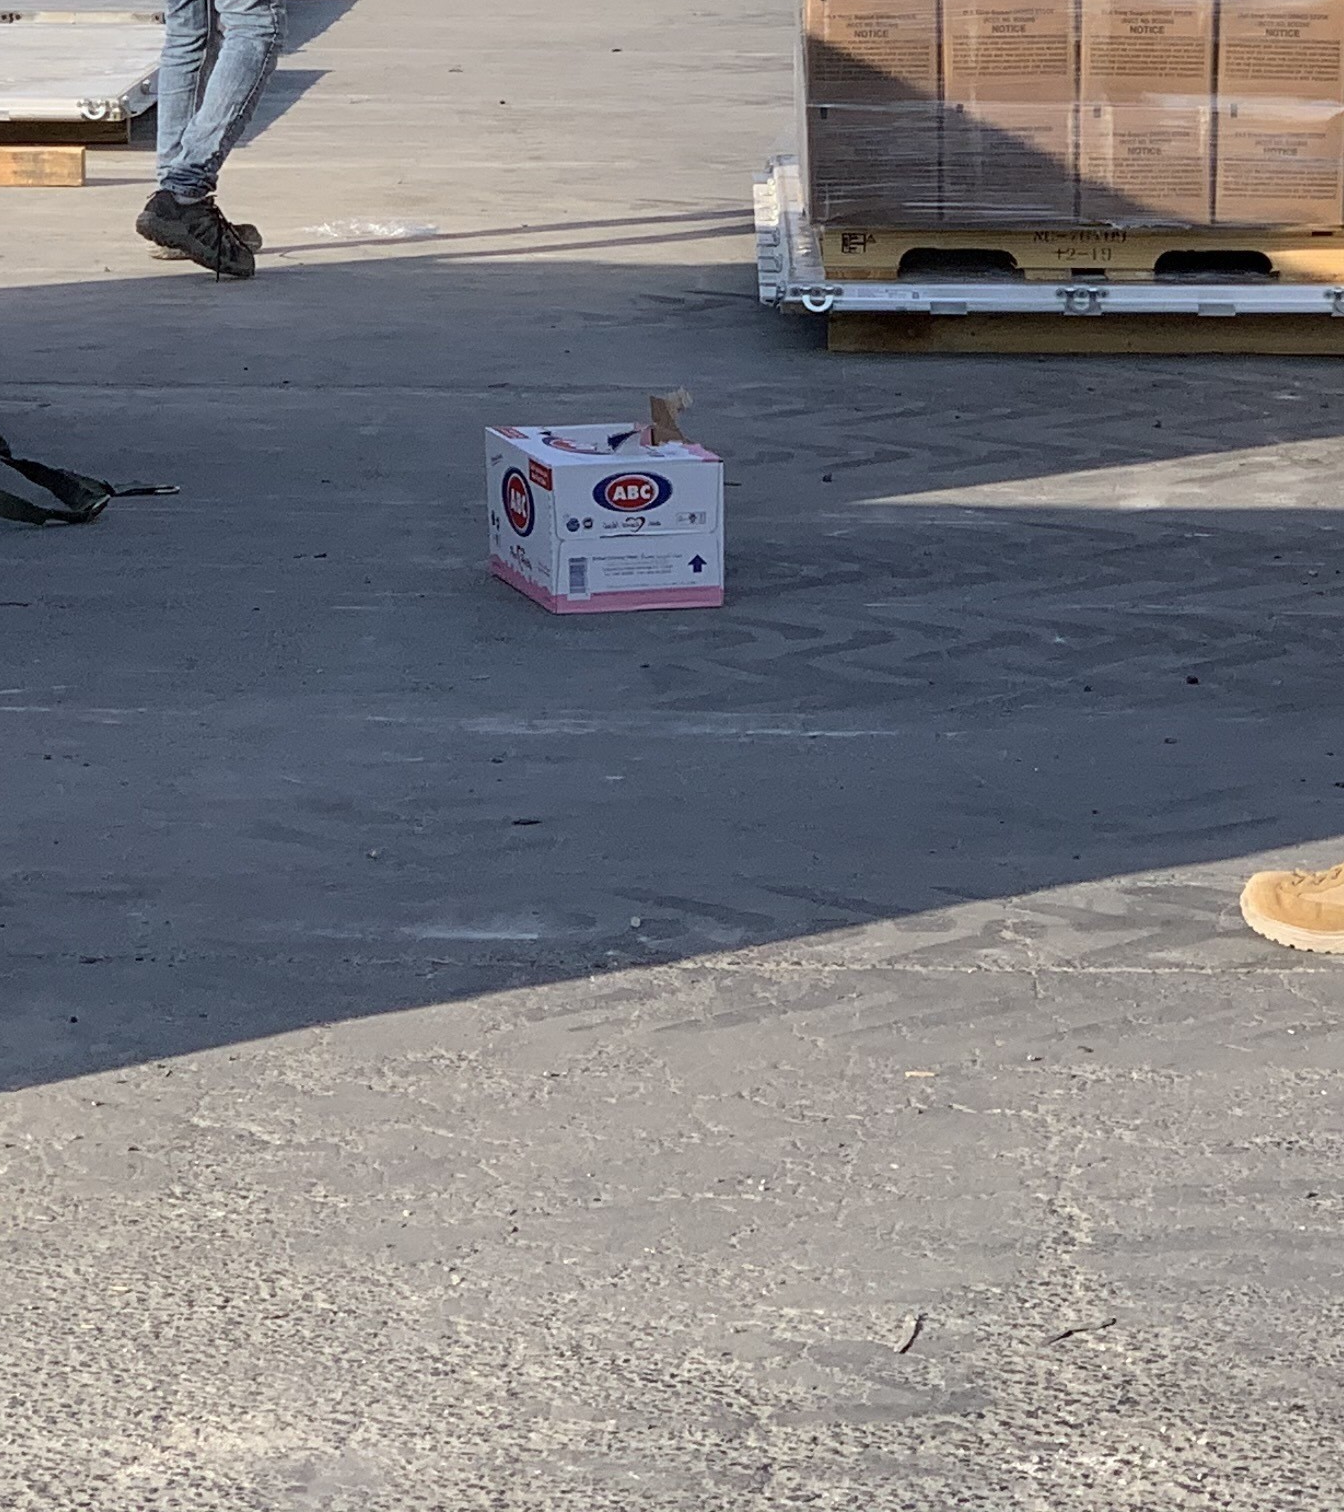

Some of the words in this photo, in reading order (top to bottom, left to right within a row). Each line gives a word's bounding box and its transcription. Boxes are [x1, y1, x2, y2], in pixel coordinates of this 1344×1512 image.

[991, 24, 1027, 33] NOTICE
[1129, 25, 1165, 34] NOTICE
[1265, 28, 1301, 38] NOTICE
[854, 29, 889, 38] NOTICE
[1127, 146, 1162, 155] NOTICE
[612, 484, 652, 502] ABC
